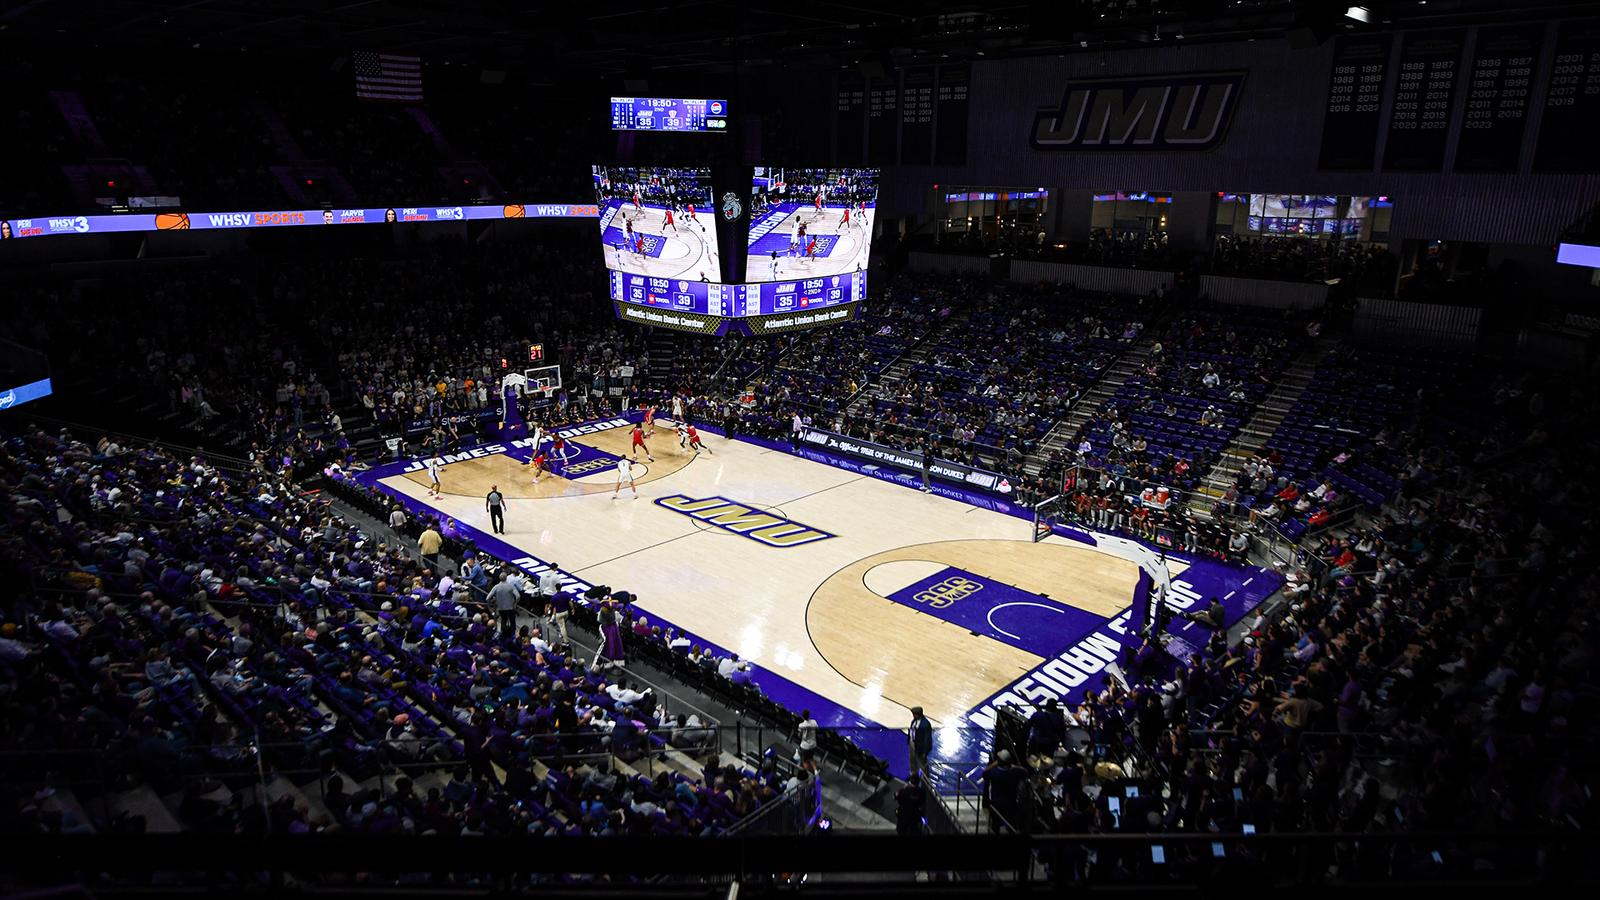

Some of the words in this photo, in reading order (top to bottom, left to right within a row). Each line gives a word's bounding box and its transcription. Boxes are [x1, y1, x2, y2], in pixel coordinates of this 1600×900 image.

[1556, 54, 1584, 63] 2001
[1359, 85, 1378, 93] 2011
[1472, 90, 1498, 98] 2007
[1397, 92, 1417, 100] 2011
[647, 99, 672, 107] 19:50
[1034, 80, 1236, 146] JMU
[639, 118, 652, 126] 35
[667, 118, 679, 126] 39
[341, 209, 364, 217] JARVIS
[454, 206, 463, 220] 3
[537, 205, 567, 216] WHSV
[48, 218, 75, 228] WHSV
[75, 216, 90, 233] 3
[208, 213, 251, 227] WHSV
[254, 211, 305, 225] SPORTS
[648, 277, 669, 289] 19:50
[802, 279, 824, 289] 19:50
[632, 289, 643, 299] 35
[830, 289, 841, 299] 39
[678, 295, 691, 305] 39
[779, 296, 793, 307] 35
[626, 308, 645, 318] Atlantic
[646, 312, 663, 322] Union
[663, 315, 680, 325] Bank
[680, 317, 705, 328] Center
[764, 316, 794, 329] Atlantic
[794, 314, 814, 325] Union
[814, 311, 830, 322] Bank
[830, 309, 849, 319] Center
[530, 350, 542, 360] 21
[403, 444, 508, 473] JAMES
[510, 418, 631, 449] MADISON
[805, 431, 829, 445] JMU
[828, 439, 838, 448] The
[839, 441, 860, 452] Official
[874, 451, 884, 459] OF
[883, 453, 895, 462] THE
[894, 456, 914, 466] JAMES
[913, 459, 943, 474] MASON
[943, 468, 965, 480] DUKES
[966, 471, 995, 488] JMU
[656, 495, 834, 547] JMU
[912, 576, 984, 609] SBC
